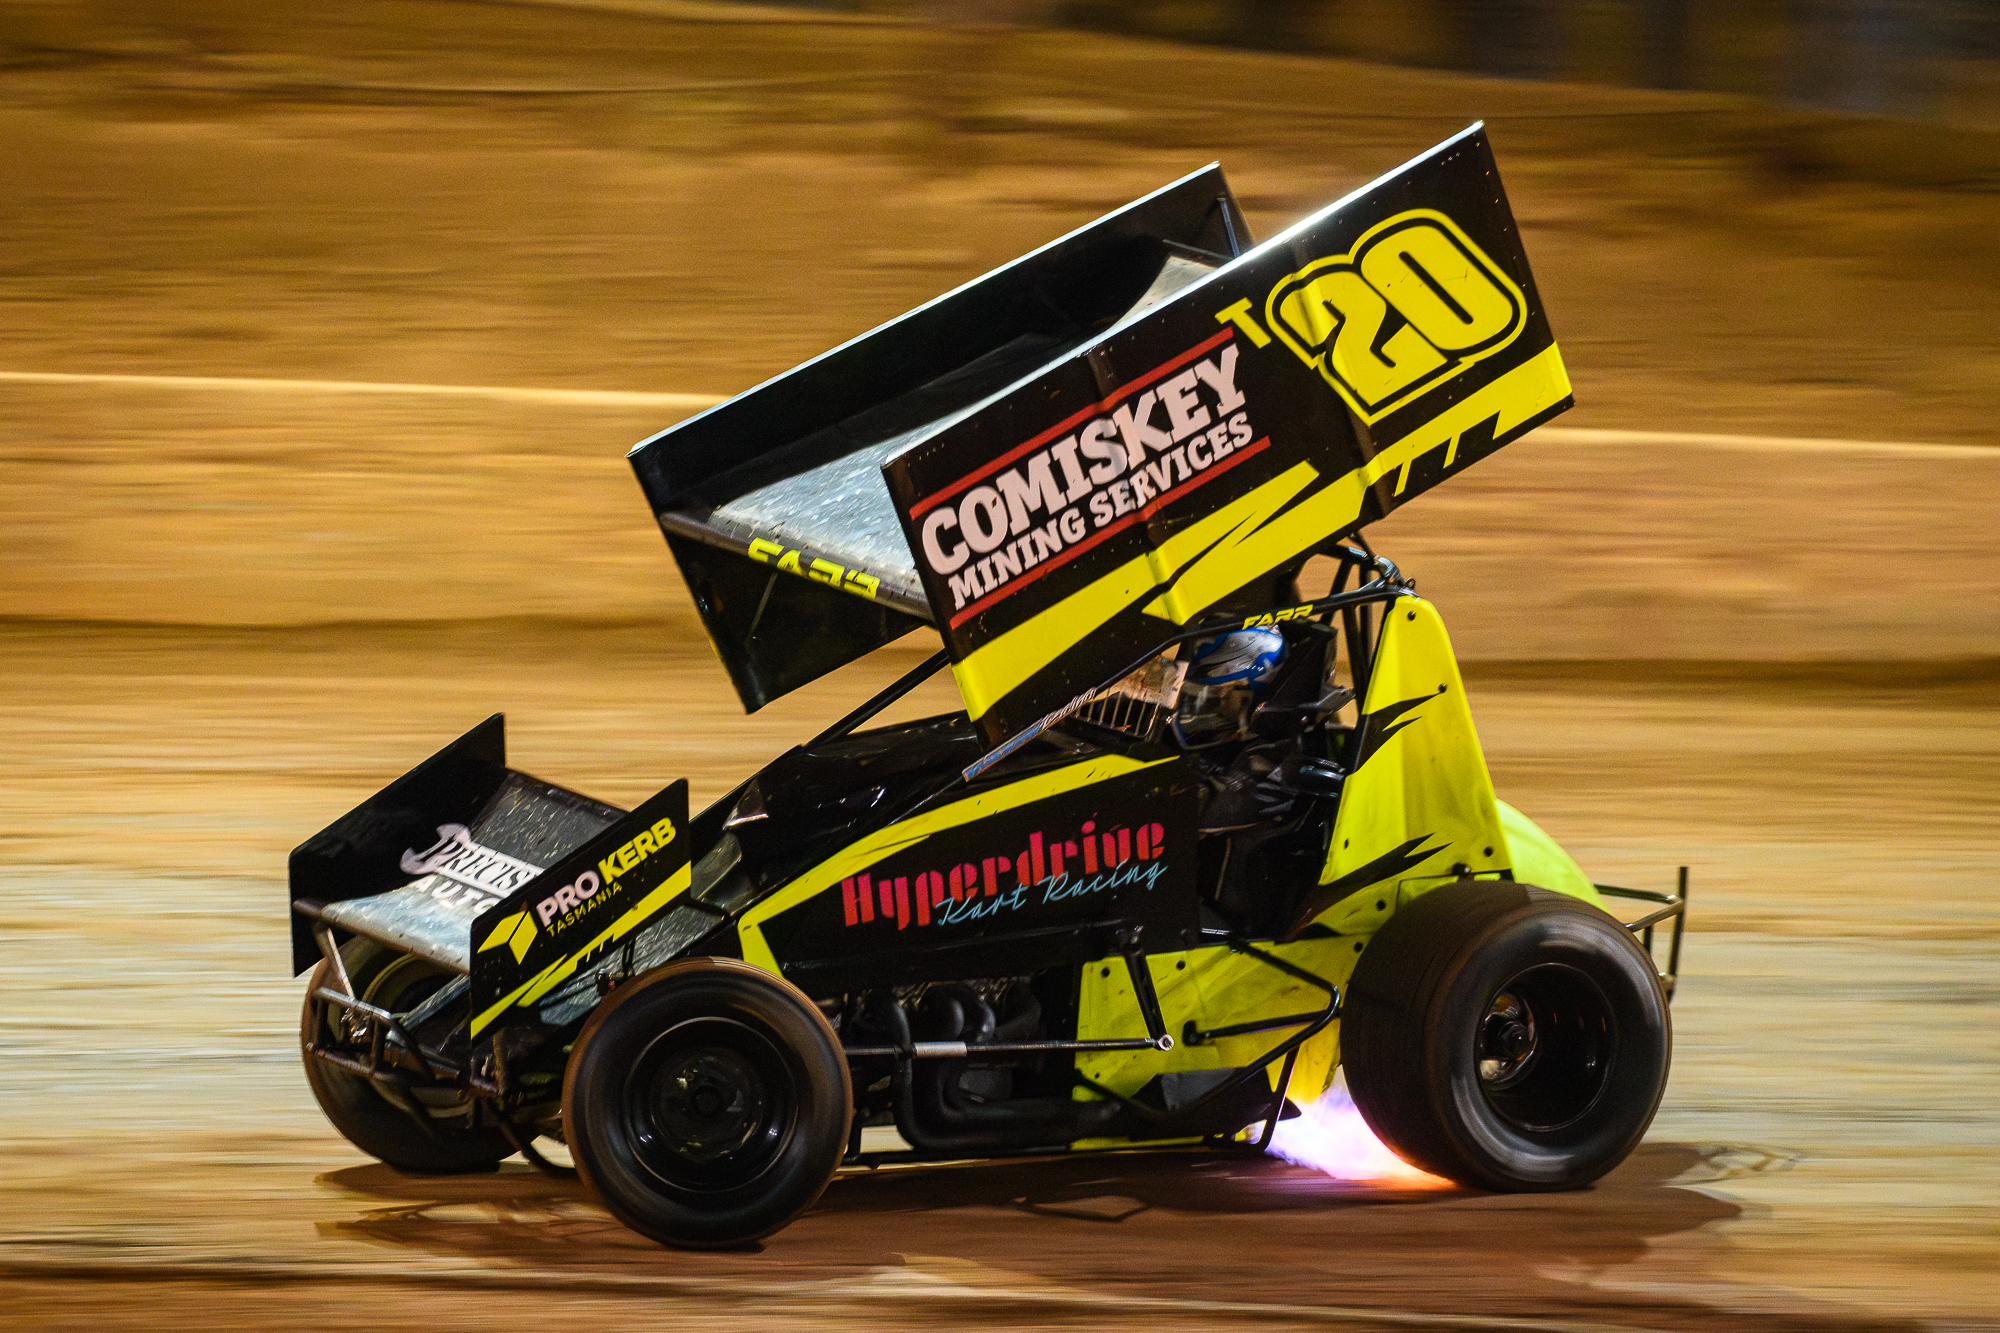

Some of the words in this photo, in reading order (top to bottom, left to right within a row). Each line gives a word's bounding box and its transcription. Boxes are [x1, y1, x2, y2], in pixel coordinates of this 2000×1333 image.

[1214, 296, 1272, 349] T
[1265, 208, 1527, 427] 20
[921, 343, 1246, 576] COMISKEY
[947, 506, 1087, 611] MINING
[1089, 411, 1253, 528] SERVICES
[1241, 604, 1314, 631] FARR
[536, 869, 600, 928] PRO
[597, 816, 677, 886] KERB
[546, 881, 623, 938] TASMANIA
[841, 820, 1165, 931] Hyperdrive
[935, 882, 1029, 926] Kart
[1036, 857, 1168, 905] Racing
